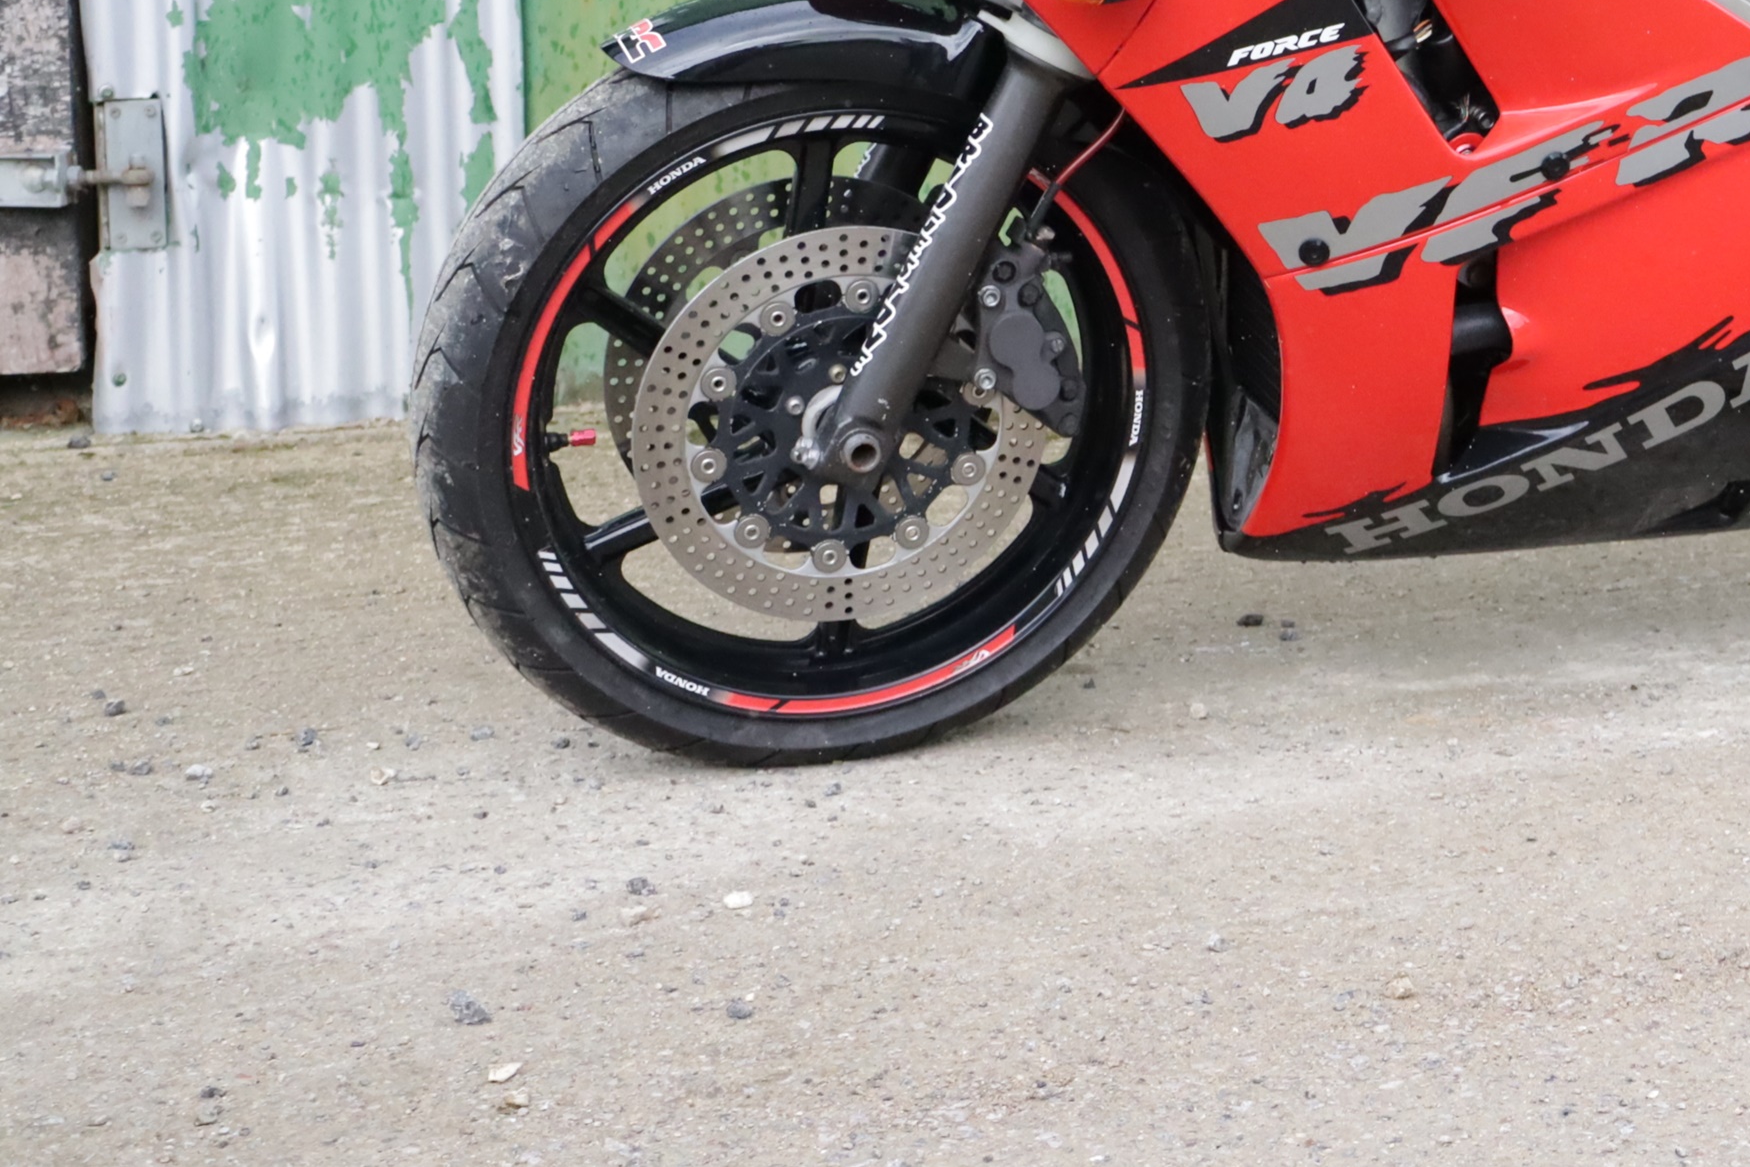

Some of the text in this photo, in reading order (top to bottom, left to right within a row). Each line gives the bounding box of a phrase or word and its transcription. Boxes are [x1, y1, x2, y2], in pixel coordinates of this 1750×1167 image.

[1226, 22, 1346, 68] FORCE
[1180, 44, 1369, 143] V4
[646, 155, 707, 195] HONDA
[1128, 389, 1144, 447] HONDA
[655, 665, 711, 697] HONDA
